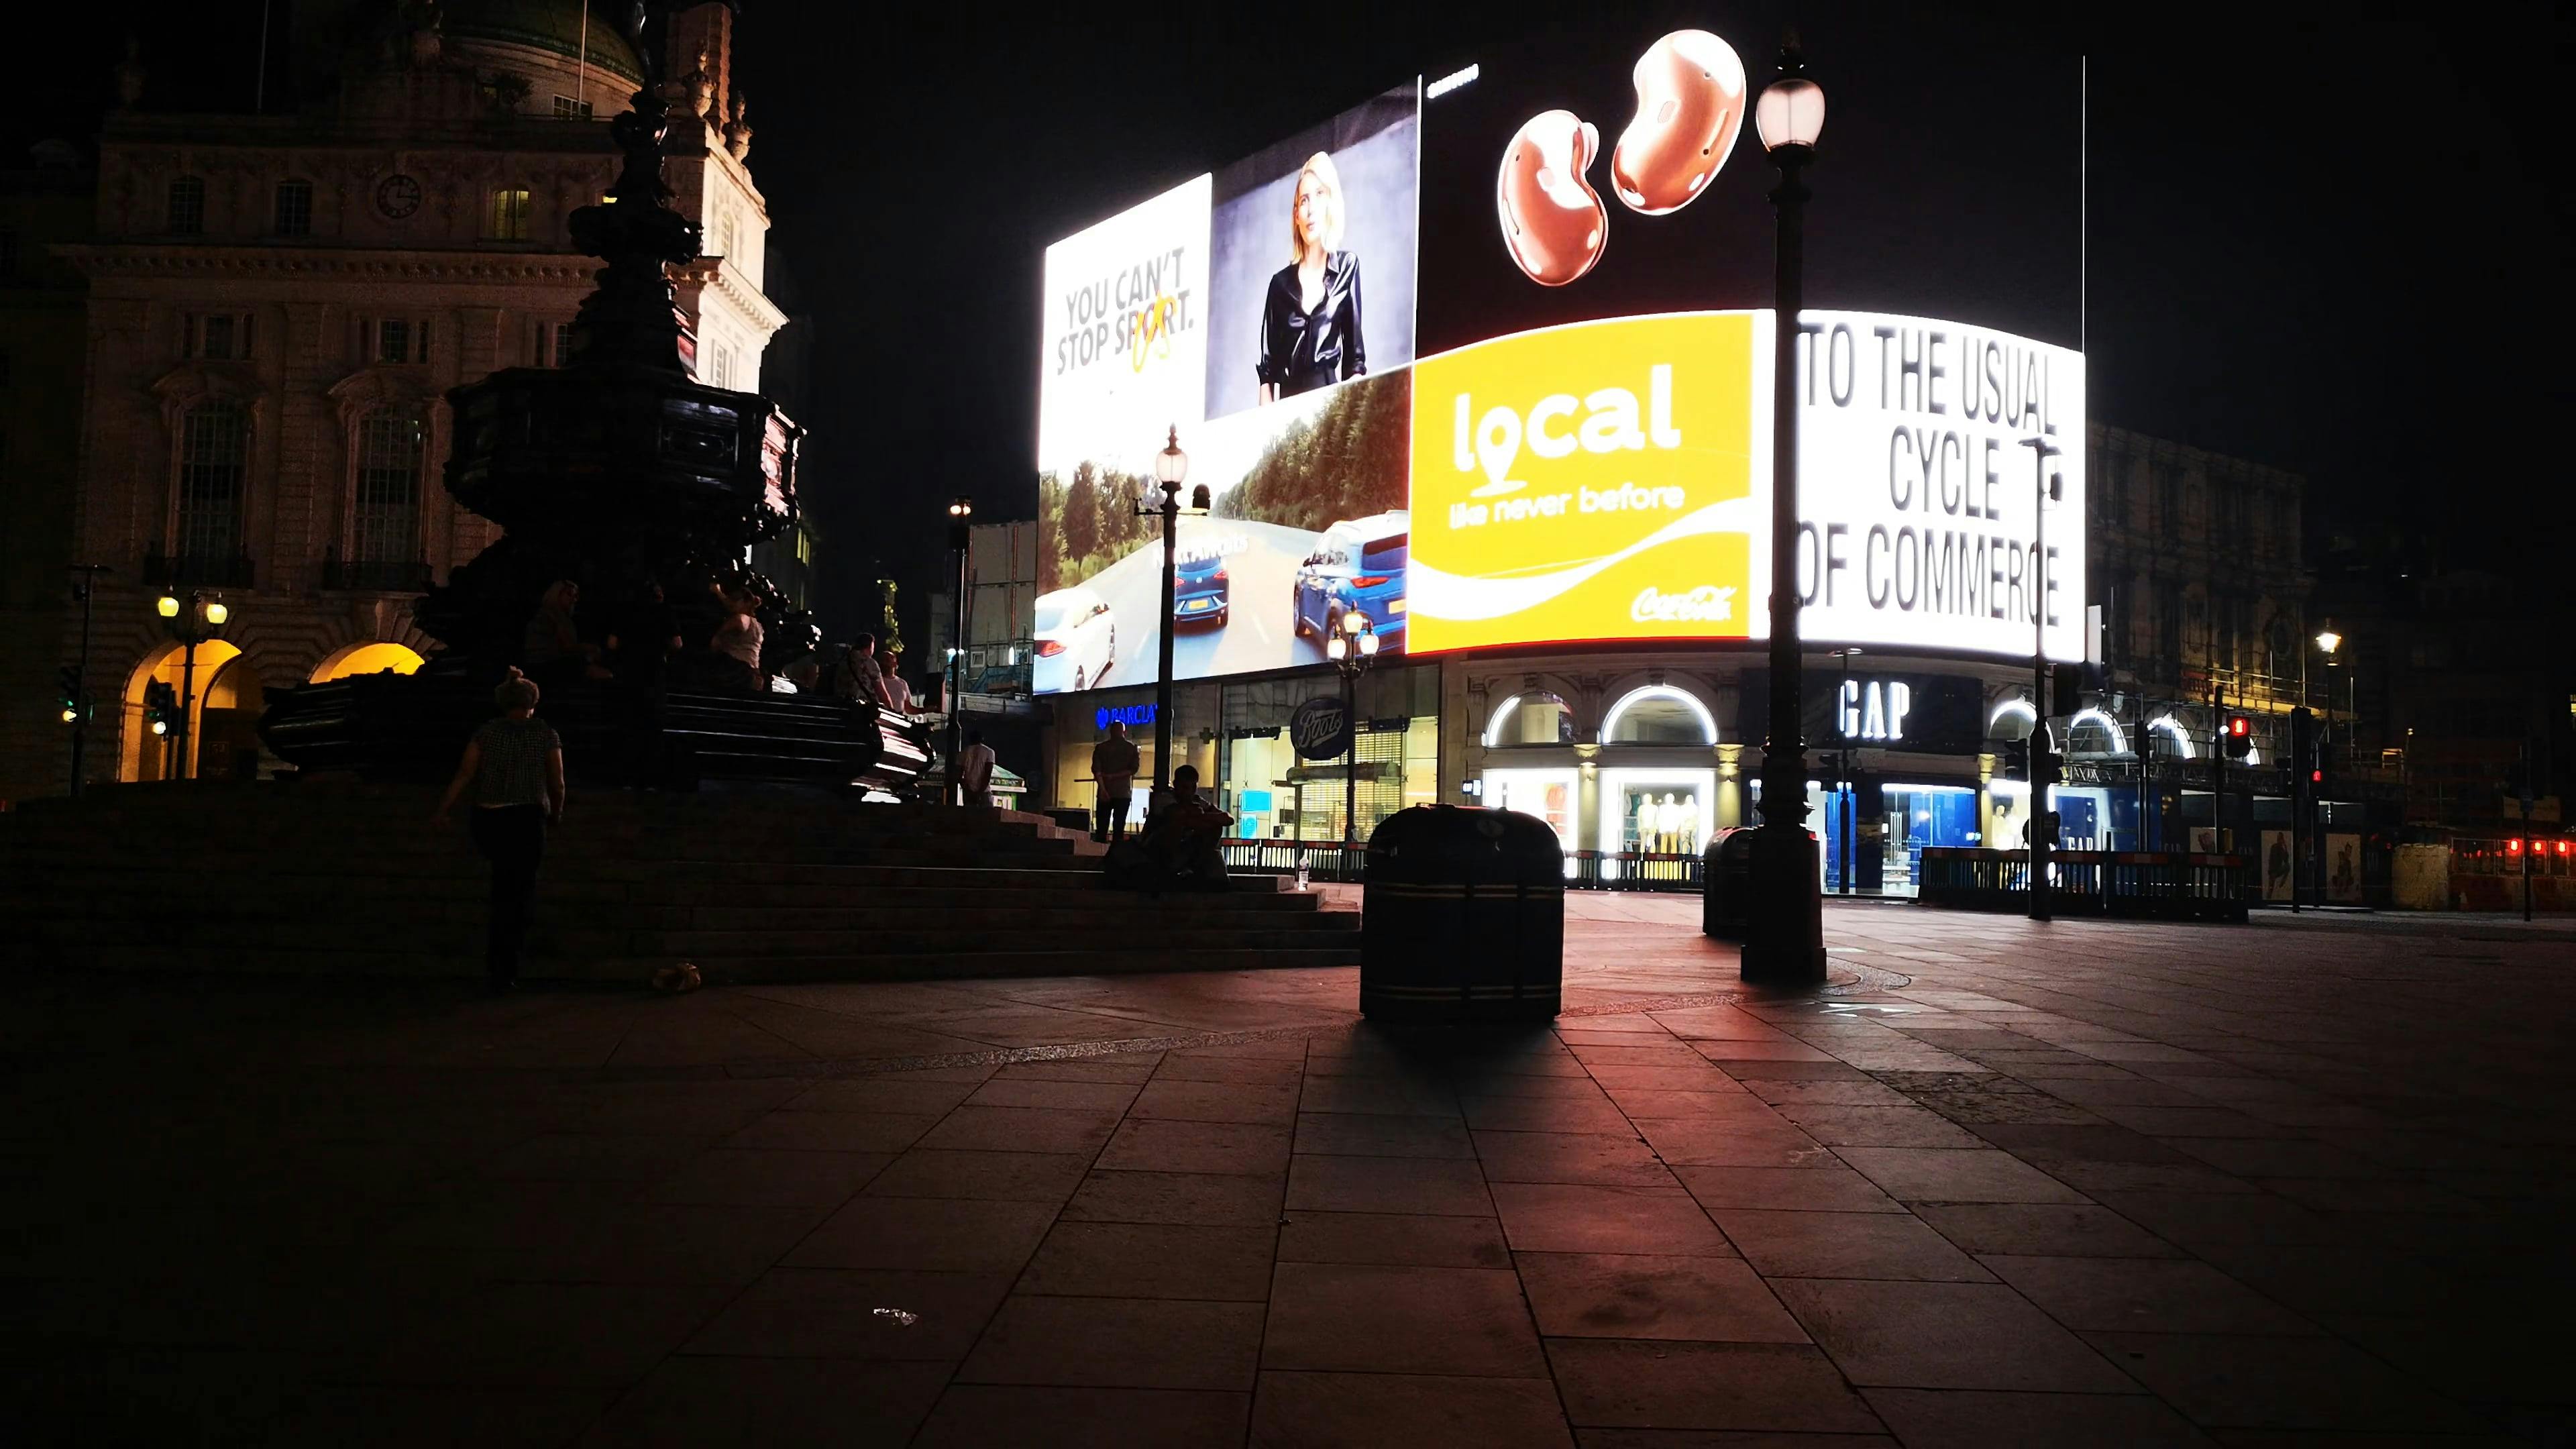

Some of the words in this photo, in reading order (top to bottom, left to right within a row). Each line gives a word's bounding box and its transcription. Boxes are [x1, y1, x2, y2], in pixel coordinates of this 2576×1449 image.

[1066, 278, 1108, 329] YOU
[1116, 246, 1185, 311] CAN'T
[1057, 322, 1109, 376] STOP
[1114, 288, 1193, 356] SPORT.
[1799, 322, 1855, 408] TO
[1874, 325, 1947, 415] THE
[1962, 335, 2058, 437] USUAL
[1454, 364, 1682, 488] local
[1449, 500, 1488, 529] like
[1494, 493, 1572, 523] never
[1578, 482, 1685, 515] before
[1889, 425, 2000, 521] CYCLE
[1799, 520, 1849, 607] OF
[1866, 523, 2059, 628] COMMERCE
[1111, 703, 1159, 725] BARCLA
[1298, 708, 1343, 748] Boots
[1839, 680, 1910, 739] GAP
